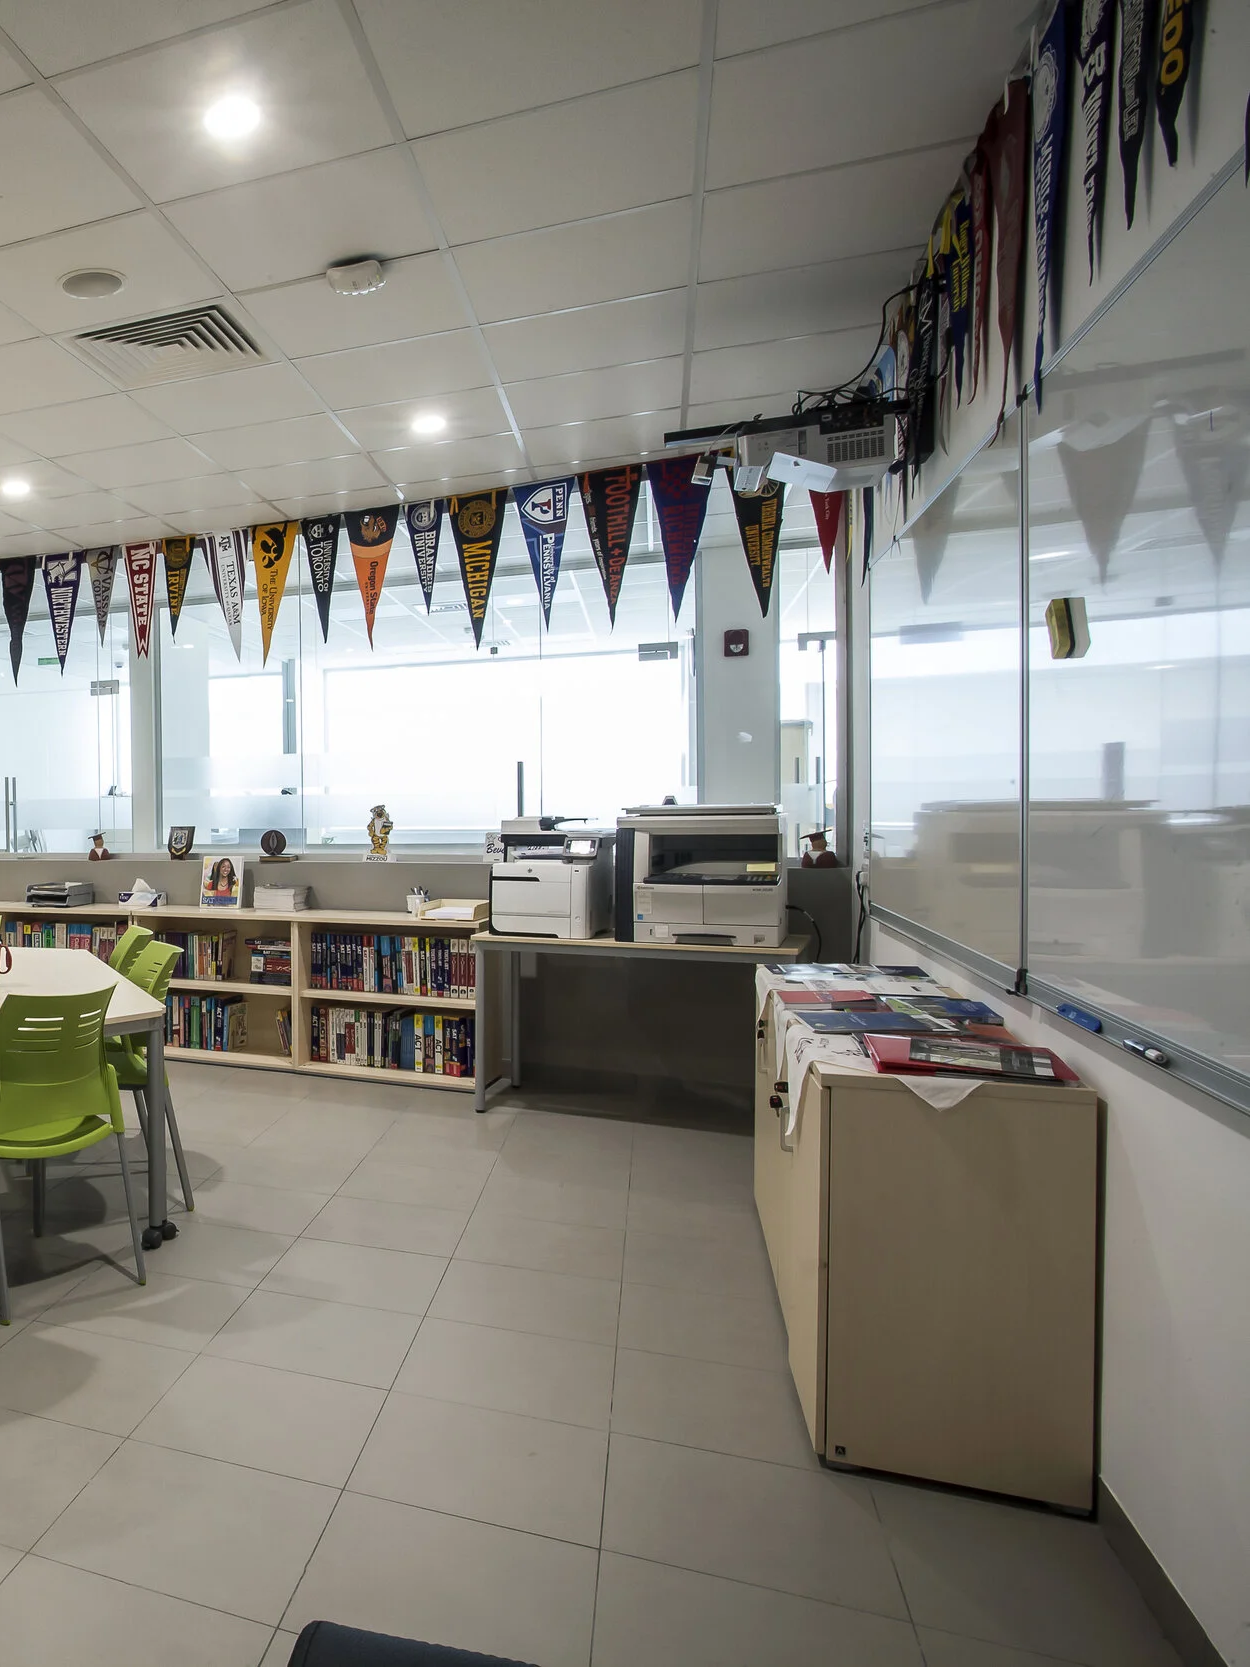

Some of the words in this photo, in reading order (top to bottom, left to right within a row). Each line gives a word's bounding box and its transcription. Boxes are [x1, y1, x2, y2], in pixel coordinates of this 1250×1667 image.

[1160, 0, 1184, 85] EDO
[554, 487, 564, 517] PENN
[762, 498, 778, 533] VIRGINIA
[130, 549, 150, 571] NC
[310, 542, 324, 592] TORONTO
[323, 540, 334, 583] UNIVERSITY
[414, 532, 428, 592] UNIVERSITY
[424, 530, 436, 593] BRANDEIS
[744, 524, 760, 568] UNIVERSITY
[762, 530, 774, 588] COMMONWEALTH
[167, 570, 180, 616] IRVINE
[221, 564, 229, 599] UNIVERSITY
[227, 561, 239, 598] TEXAS
[368, 561, 378, 591] Oregon
[462, 539, 492, 619] MICHIGAN
[542, 532, 554, 610] PENNSYLVANIA
[51, 586, 73, 656] NORTHWESTERN
[101, 576, 112, 627] VASSAR
[133, 572, 150, 627] STATE
[231, 601, 241, 625] A&M
[370, 592, 378, 614] State
[414, 1034, 422, 1051] ACT
